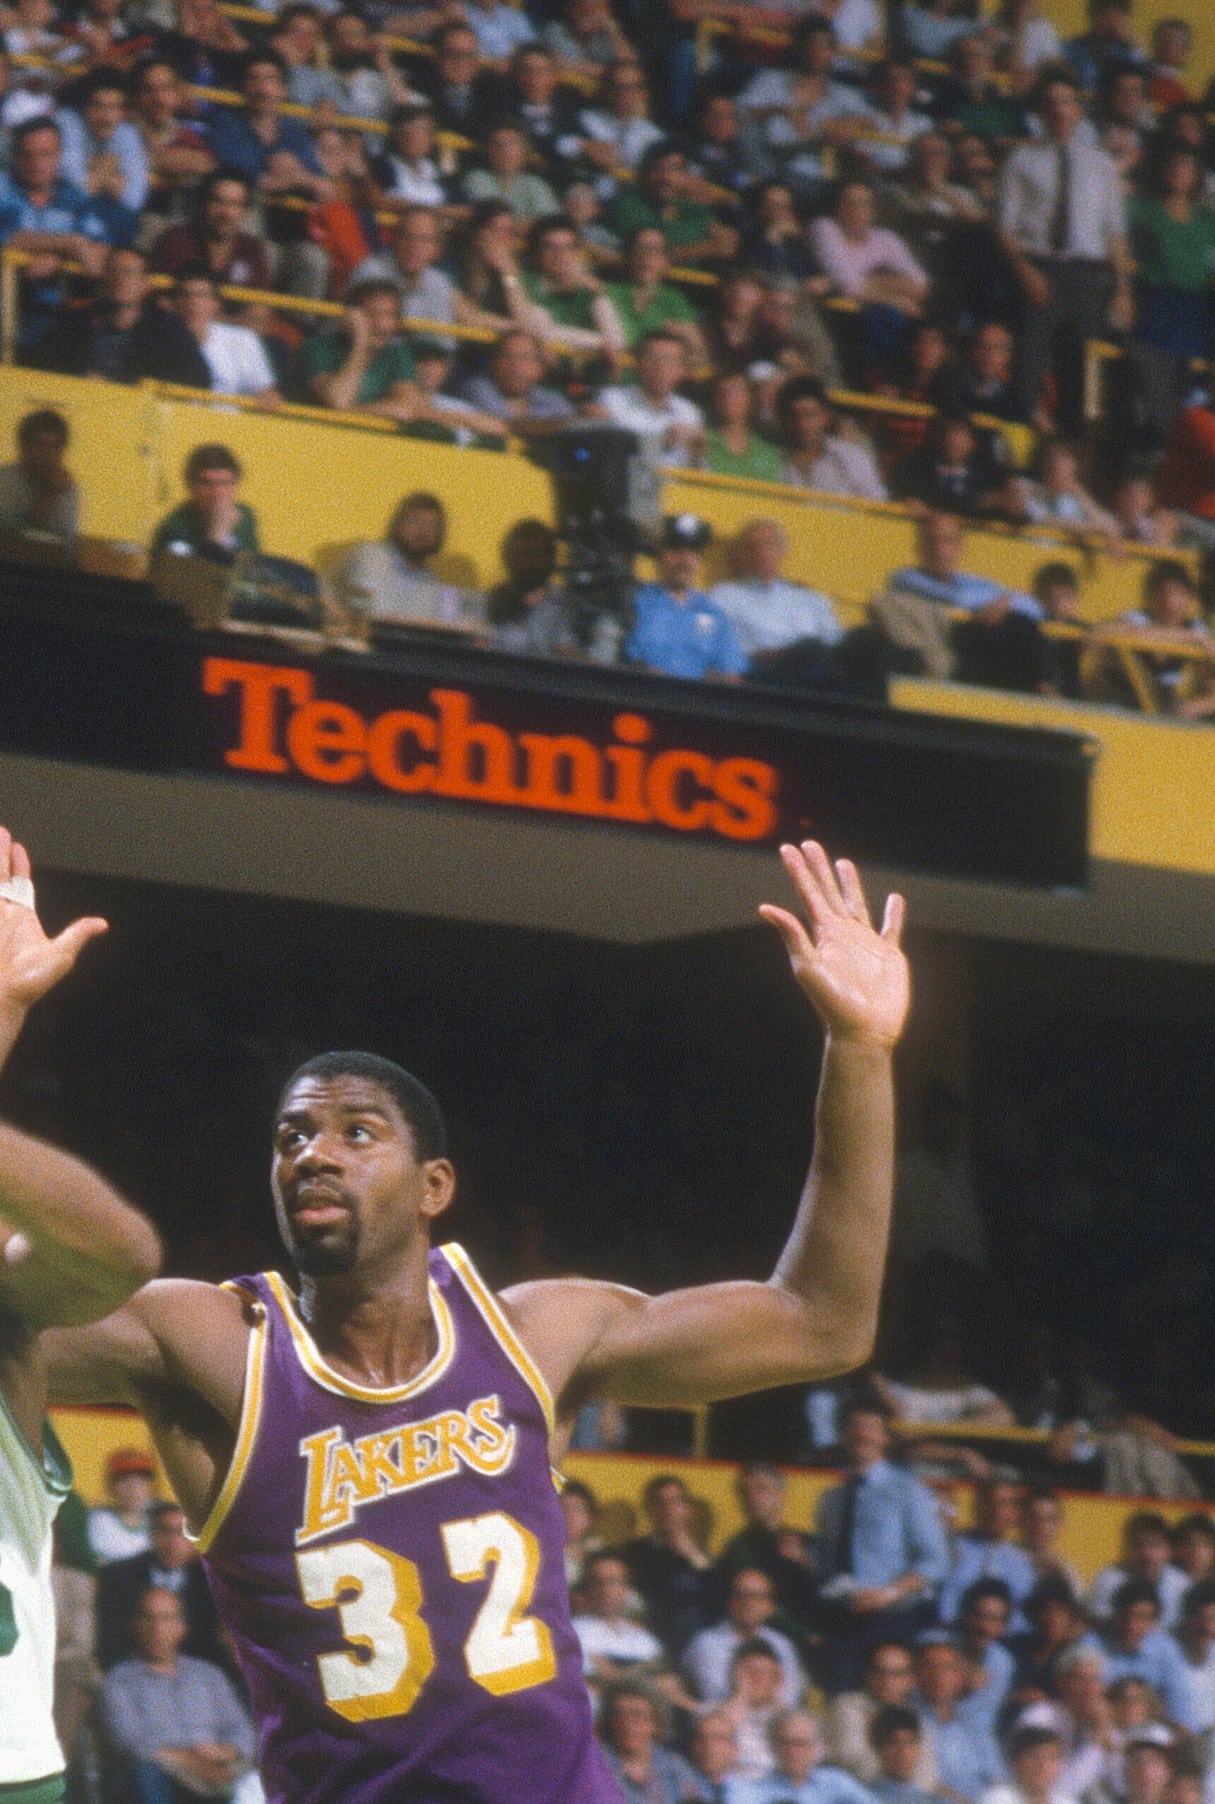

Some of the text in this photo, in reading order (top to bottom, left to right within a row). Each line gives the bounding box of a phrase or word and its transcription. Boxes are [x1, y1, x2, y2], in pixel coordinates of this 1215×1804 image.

[204, 656, 779, 842] Technics
[293, 1394, 517, 1546] LAKERS
[294, 1511, 558, 1723] 32
